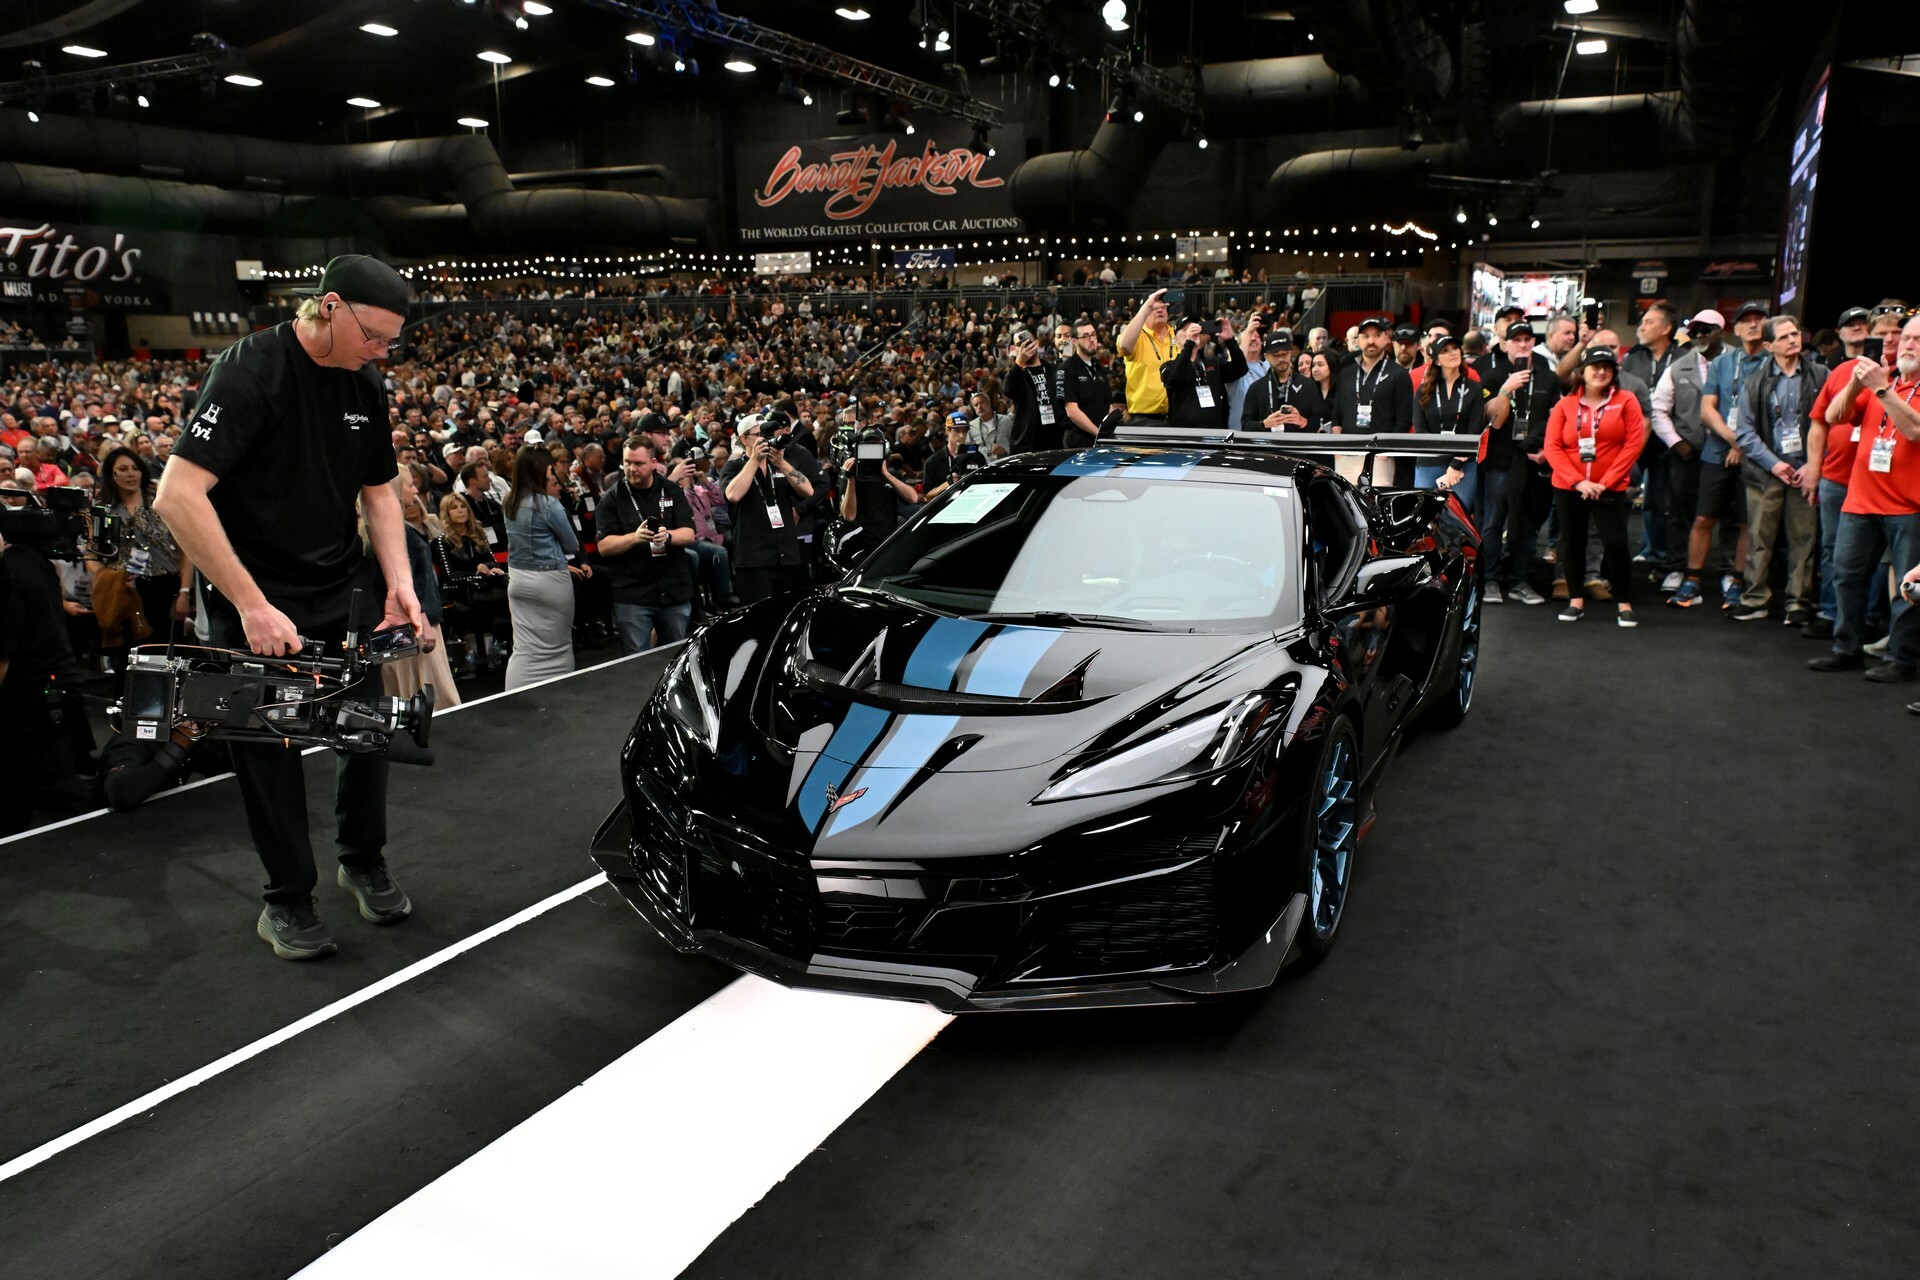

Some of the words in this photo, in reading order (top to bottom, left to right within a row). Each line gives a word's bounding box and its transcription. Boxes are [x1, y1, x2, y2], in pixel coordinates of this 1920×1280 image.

[755, 139, 1005, 219] Barrett-Jackson
[741, 227, 761, 239] THE
[764, 225, 808, 238] WORLD'S
[811, 223, 862, 237] GREATEST
[865, 221, 930, 234] COLLECTOR
[932, 219, 957, 231] CAR
[961, 217, 1018, 230] AUCTIONS
[0, 223, 142, 282] Tito's
[907, 252, 940, 269] Ford
[104, 295, 152, 306] VODKA
